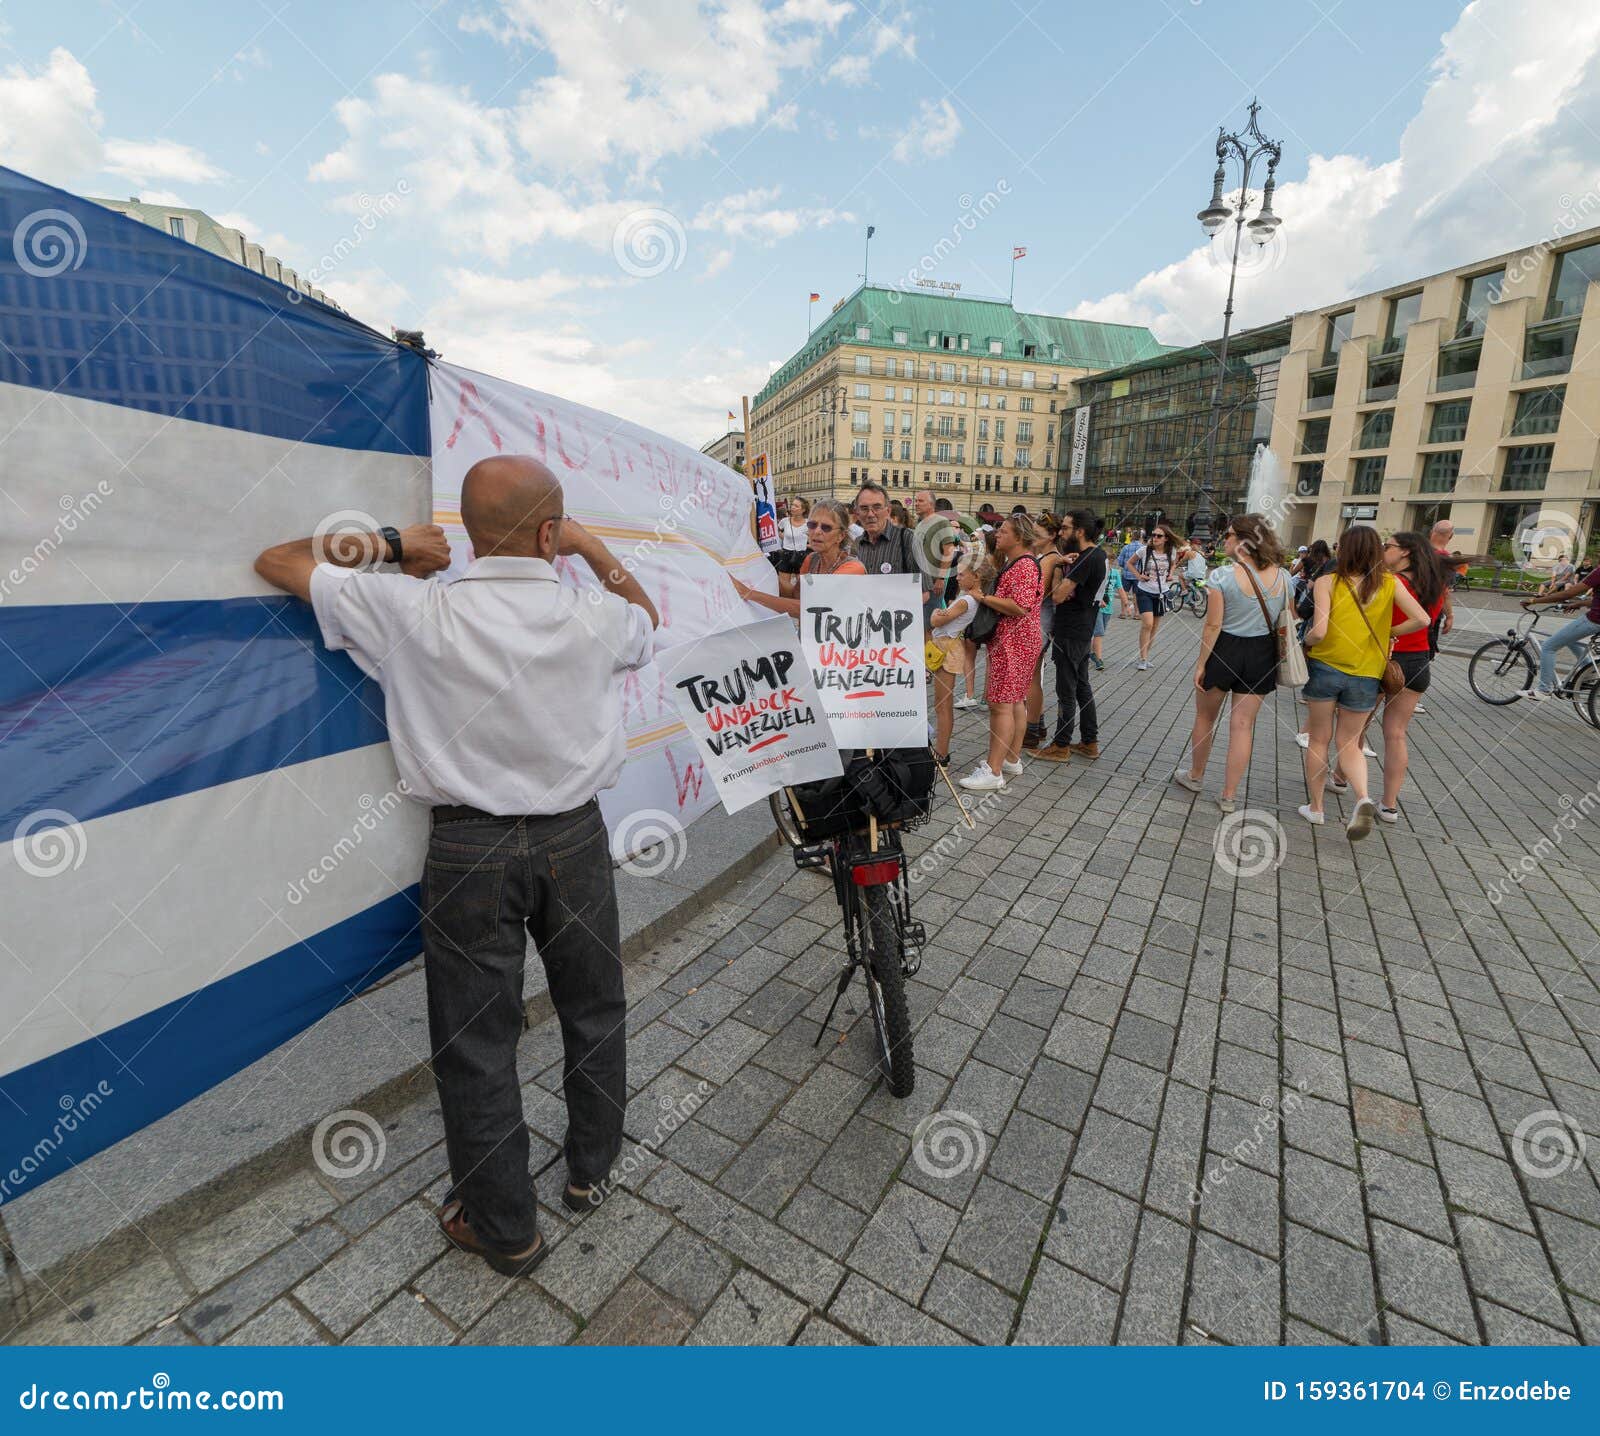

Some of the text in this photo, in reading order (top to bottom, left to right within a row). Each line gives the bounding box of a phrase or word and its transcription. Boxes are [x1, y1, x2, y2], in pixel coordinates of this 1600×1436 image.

[806, 606, 914, 650] TRUMP
[812, 665, 915, 691] VENEZUELA
[819, 642, 910, 670] UNBLOCK
[675, 650, 795, 714] TRUMP
[705, 687, 804, 733] UNBLOCK
[706, 706, 816, 757] VENEZUELA
[825, 708, 918, 720] umpUnblockVenezuela
[721, 741, 828, 785] #TrumpUnblockVenezuela
